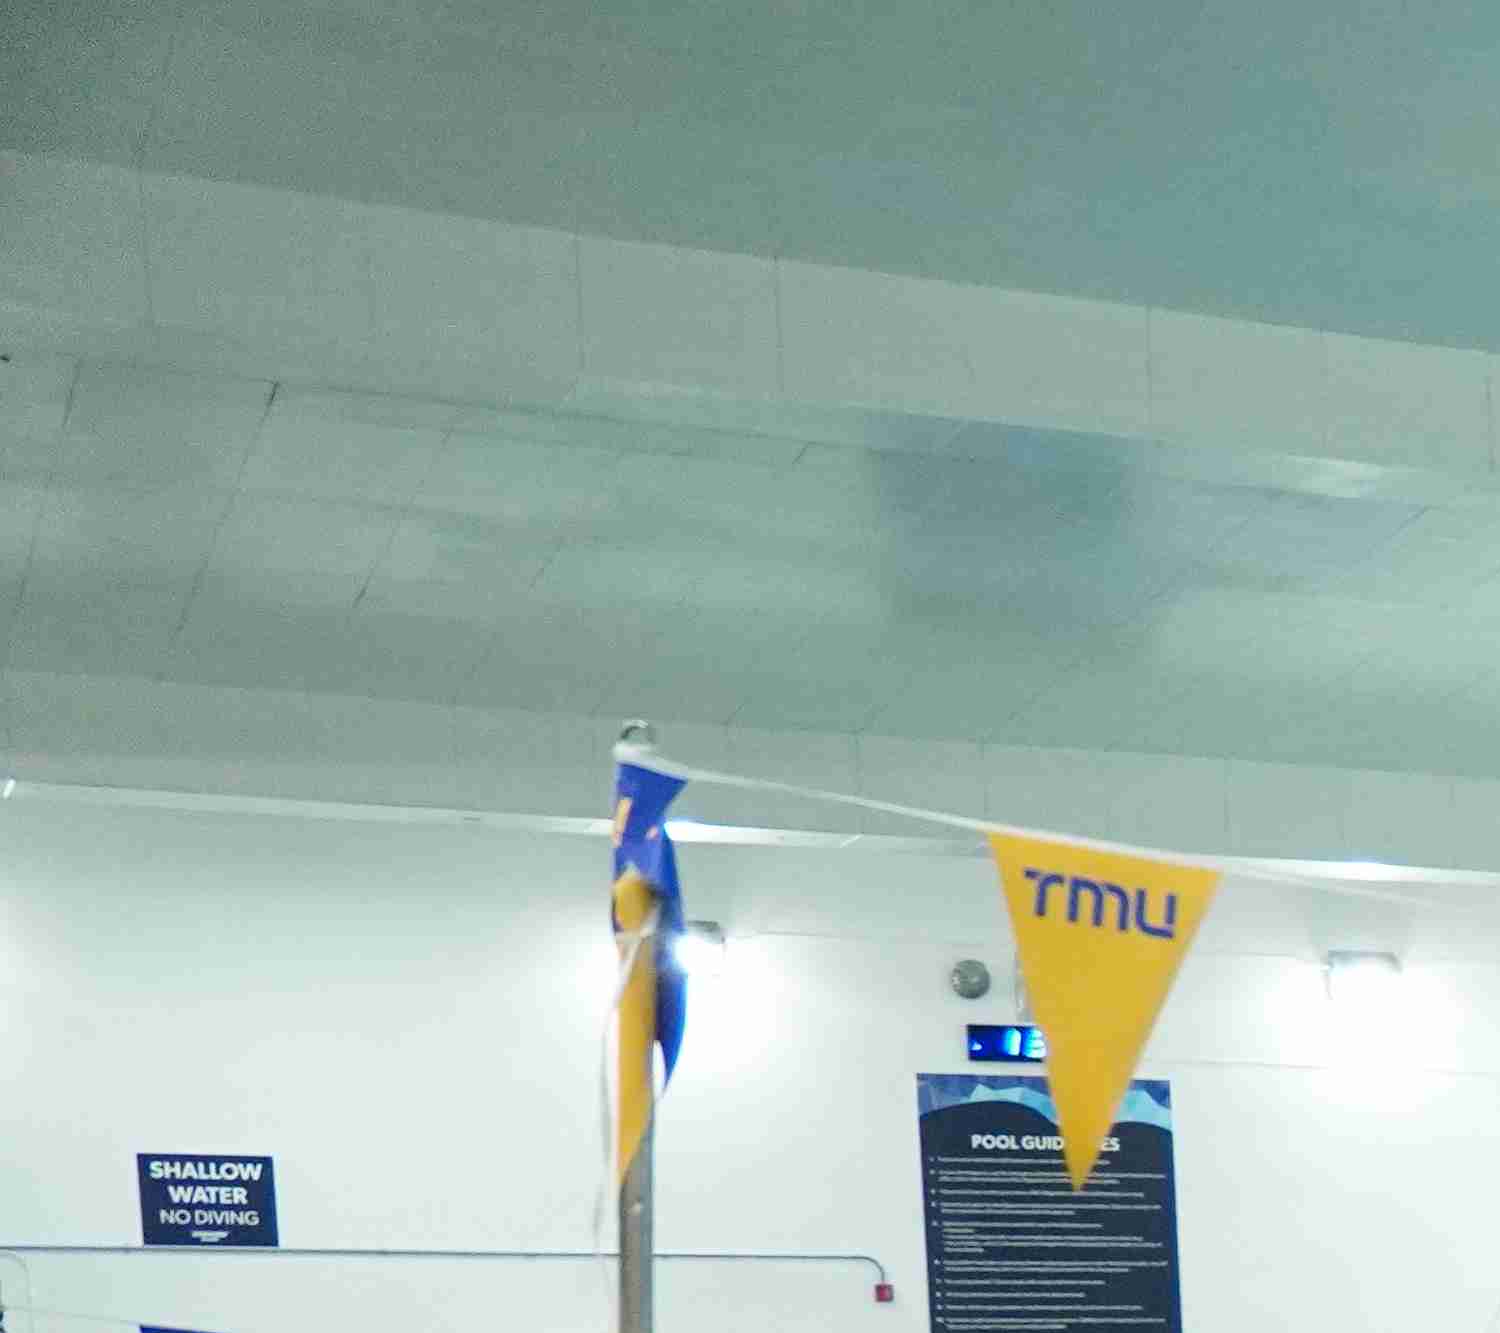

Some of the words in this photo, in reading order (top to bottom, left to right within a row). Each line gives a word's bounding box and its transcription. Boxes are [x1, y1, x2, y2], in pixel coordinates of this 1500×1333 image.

[1023, 865, 1177, 939] TMU
[971, 1134, 1019, 1149] POOL
[149, 1161, 263, 1181] SHALLOW
[167, 1185, 249, 1205] WATER
[159, 1208, 191, 1225] NO
[195, 1209, 260, 1226] DIVING
